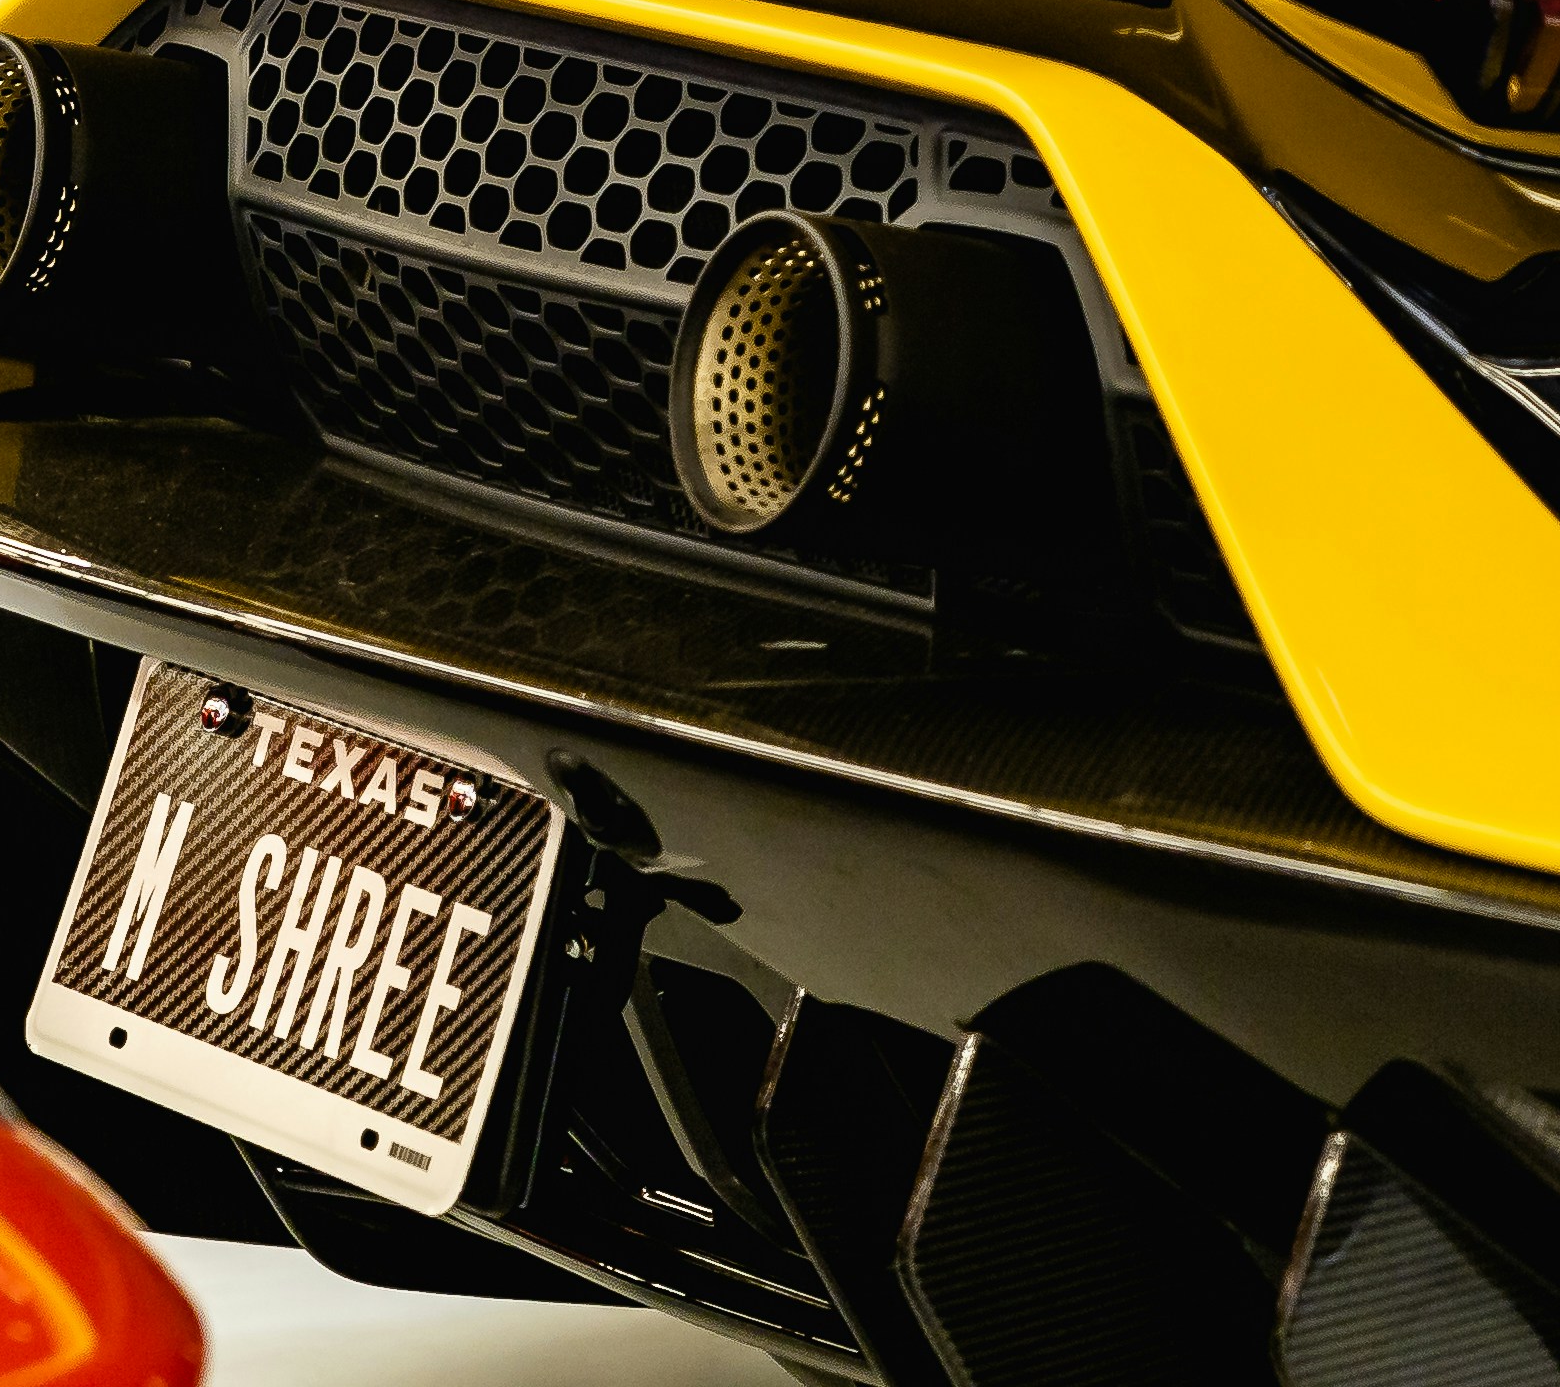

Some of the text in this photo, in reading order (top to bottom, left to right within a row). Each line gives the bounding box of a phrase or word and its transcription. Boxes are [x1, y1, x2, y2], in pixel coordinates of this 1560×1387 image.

[250, 713, 446, 829] TEXAS
[101, 791, 493, 1100] M SHREE
